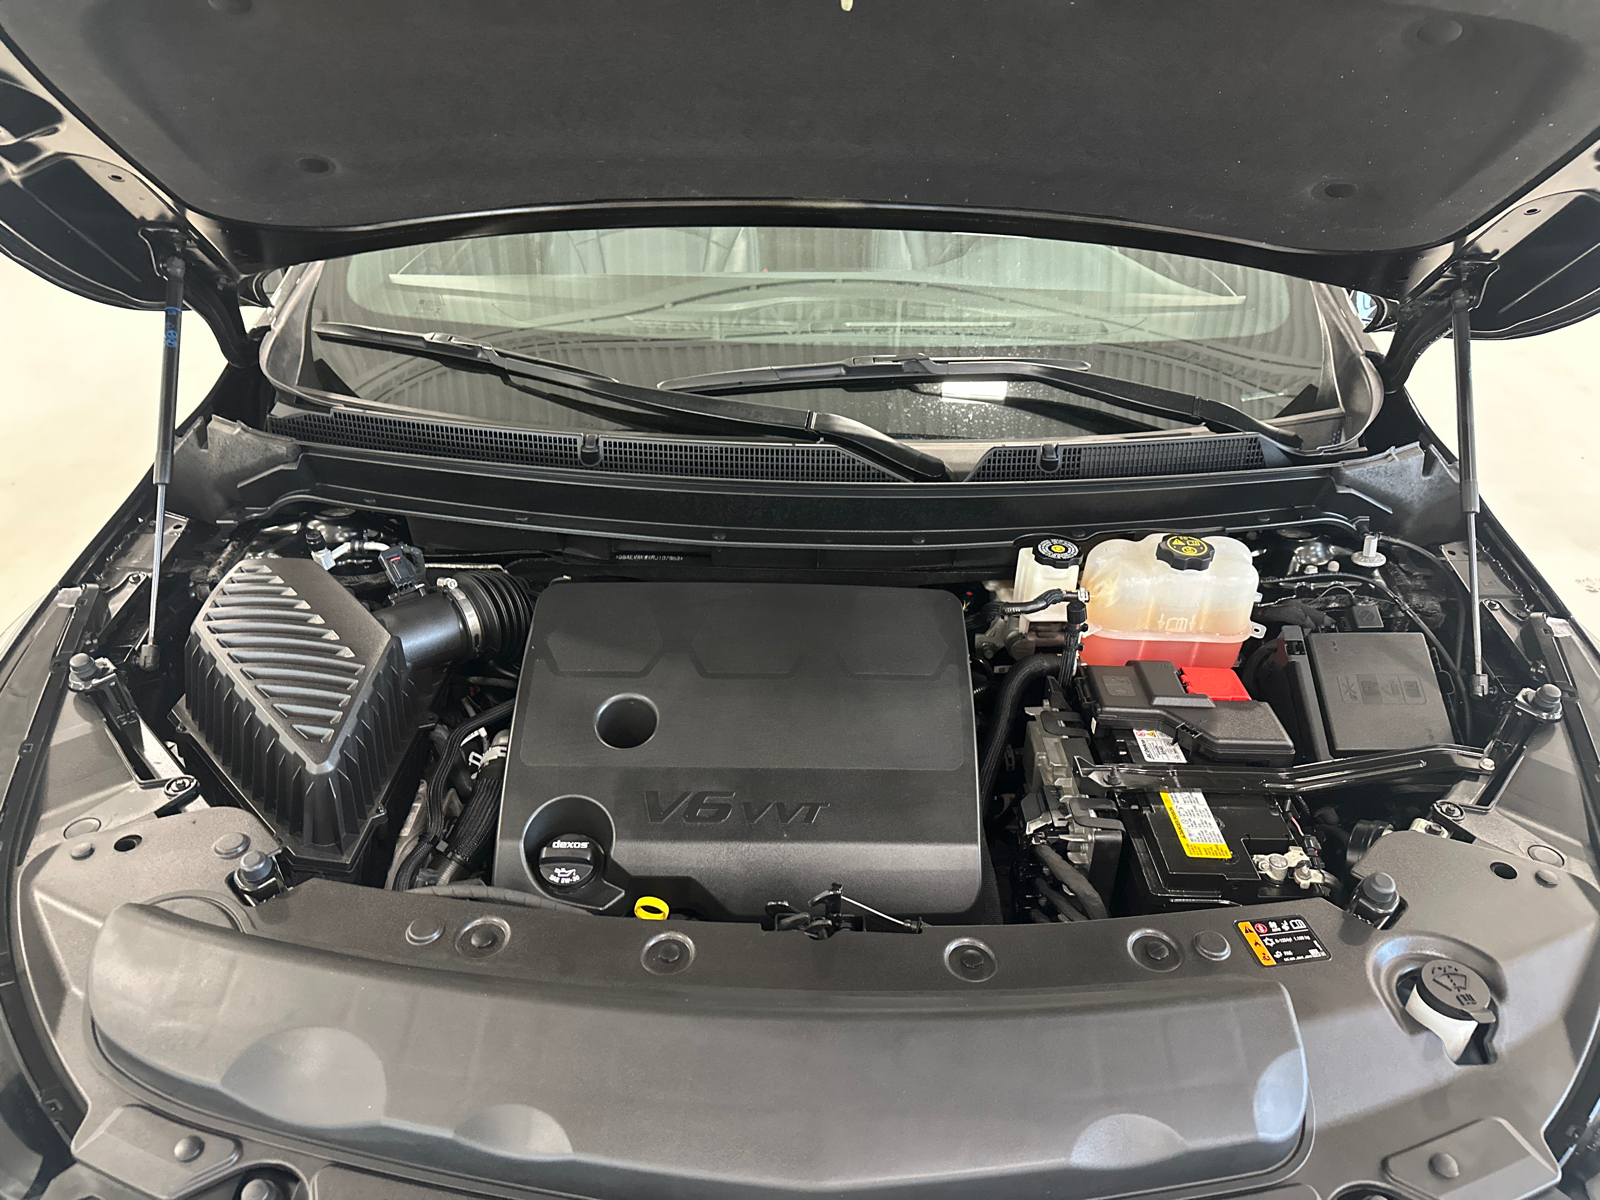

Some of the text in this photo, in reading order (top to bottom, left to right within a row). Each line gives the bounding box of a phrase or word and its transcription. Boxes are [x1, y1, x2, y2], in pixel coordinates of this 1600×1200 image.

[644, 790, 831, 824] V6 VVT
[552, 839, 590, 849] dexos
